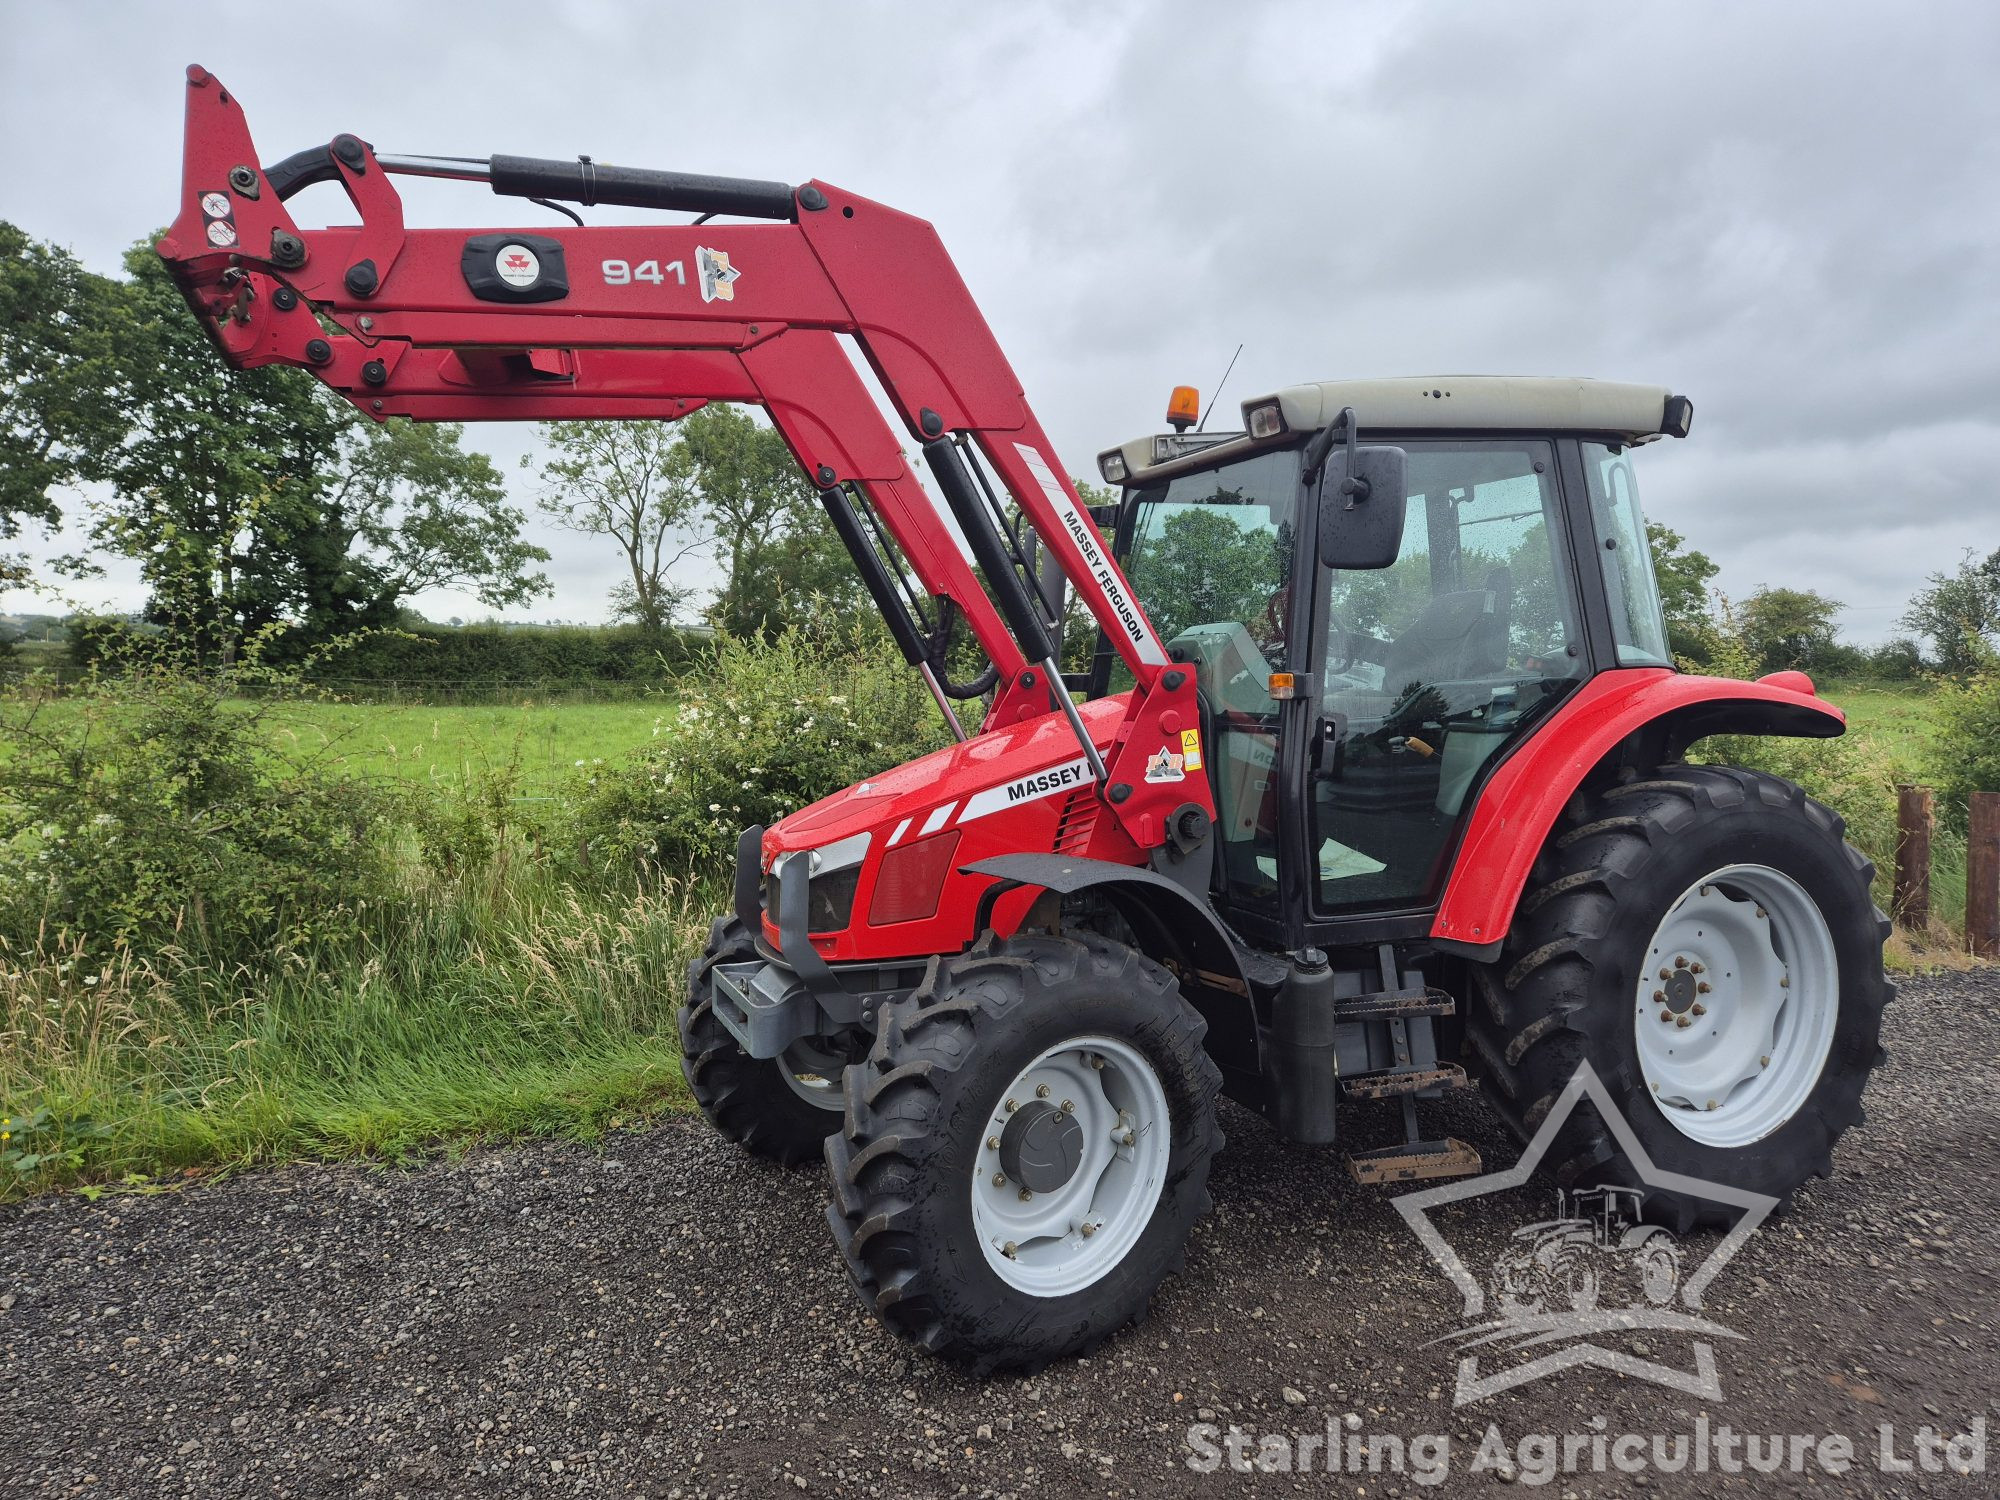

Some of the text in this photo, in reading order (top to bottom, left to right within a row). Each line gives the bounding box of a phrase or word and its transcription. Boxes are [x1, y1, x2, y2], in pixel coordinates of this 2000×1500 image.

[602, 259, 687, 286] 941
[1063, 510, 1144, 643] MASSEY FERGUSON
[1007, 764, 1081, 801] MASSEY
